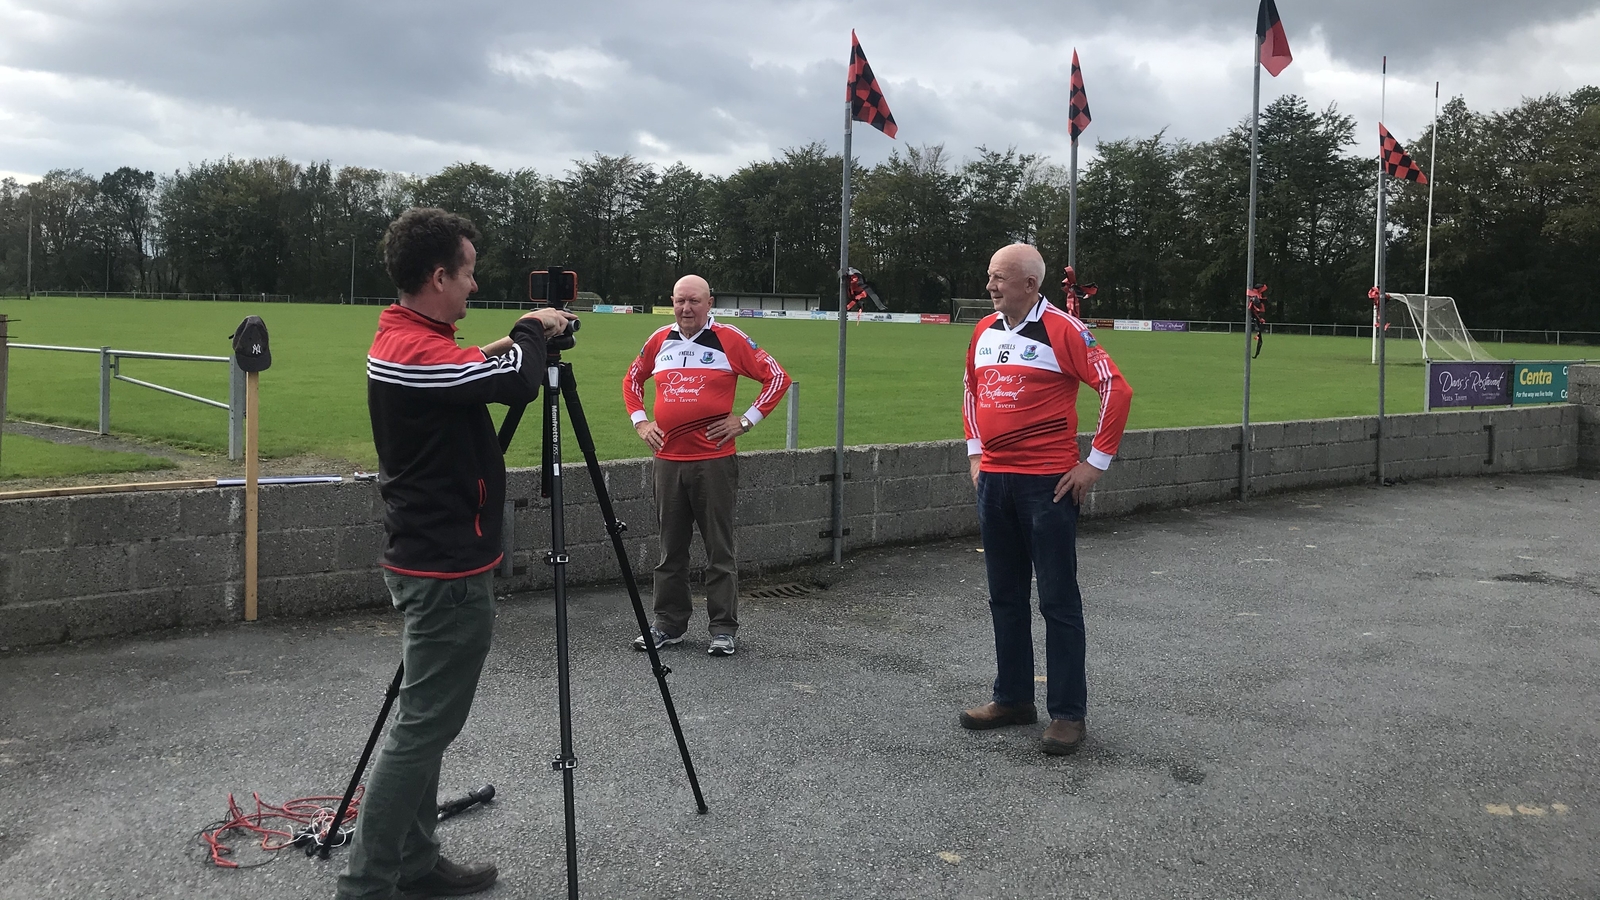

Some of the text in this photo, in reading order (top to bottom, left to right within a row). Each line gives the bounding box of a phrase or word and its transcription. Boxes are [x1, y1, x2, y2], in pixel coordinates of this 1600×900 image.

[683, 356, 687, 367] 1
[997, 350, 1010, 363] 16
[1520, 368, 1552, 385] Centra
[977, 383, 1026, 401] Restaurant
[994, 401, 1016, 409] Tavern
